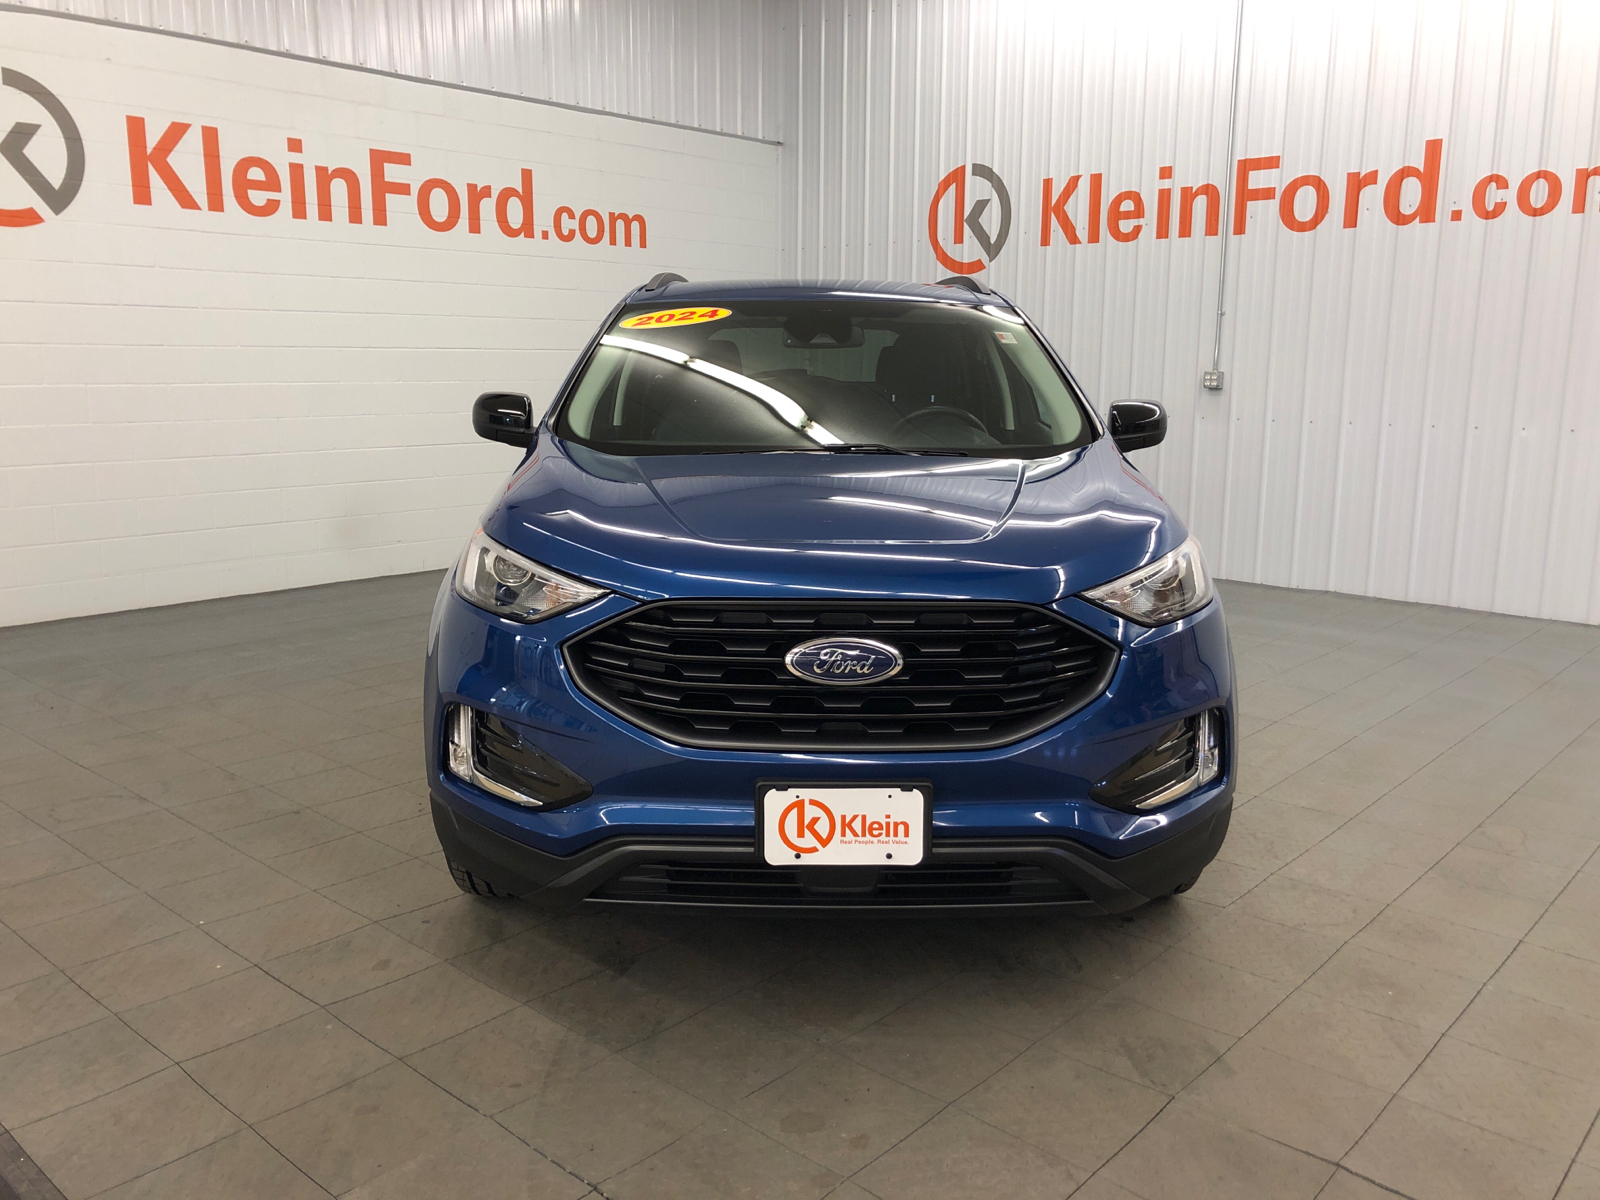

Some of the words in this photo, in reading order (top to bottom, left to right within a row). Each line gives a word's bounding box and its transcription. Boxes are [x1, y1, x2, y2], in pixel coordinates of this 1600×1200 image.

[125, 114, 648, 249] KleinFord.com
[630, 309, 720, 327] 2024
[813, 647, 877, 674] Ford
[840, 814, 910, 838] Klein
